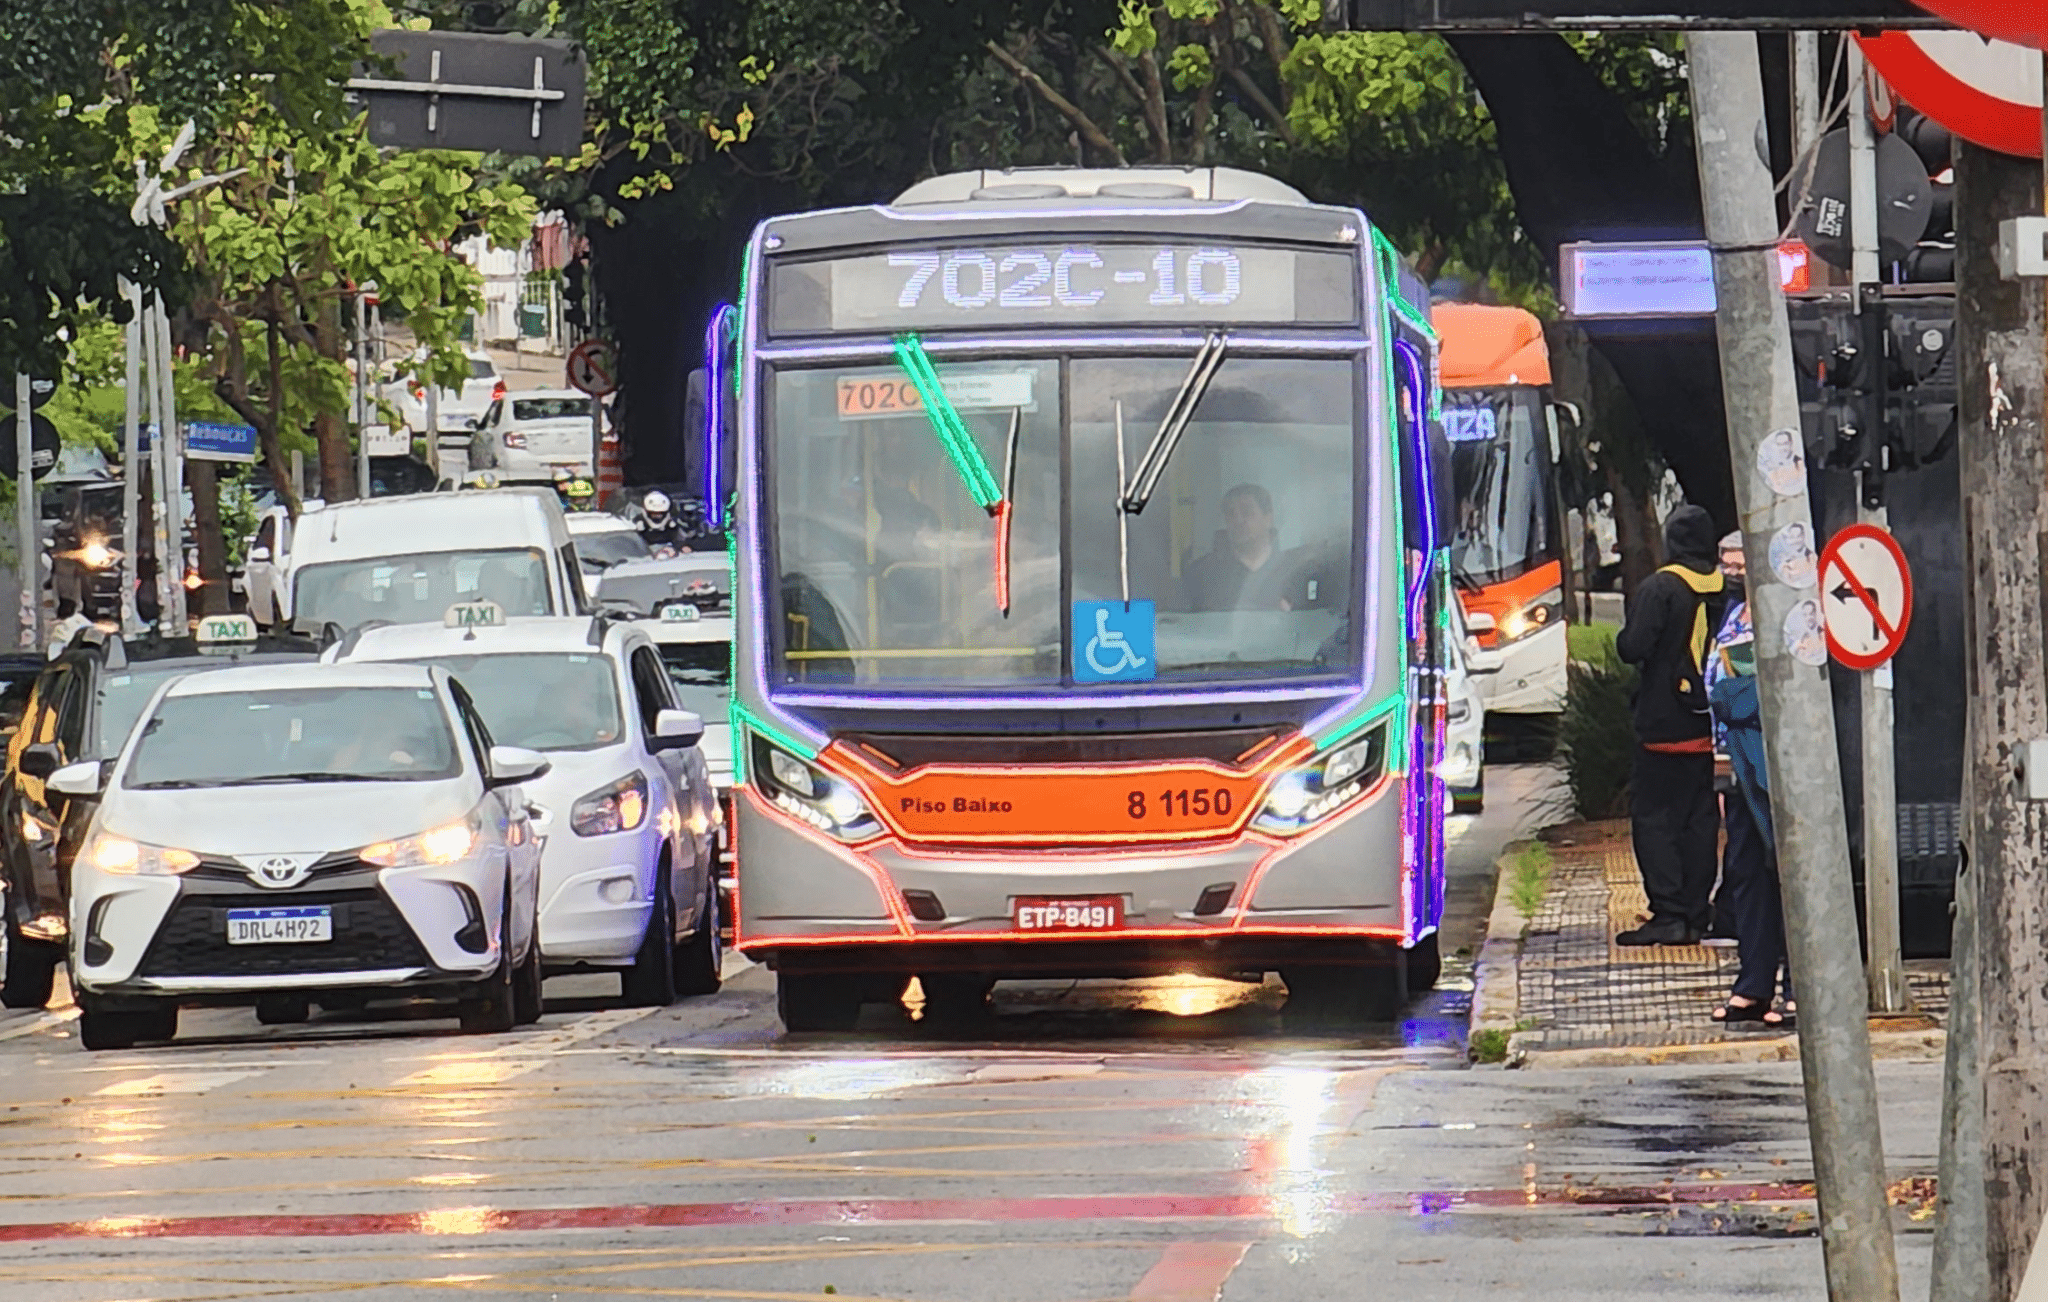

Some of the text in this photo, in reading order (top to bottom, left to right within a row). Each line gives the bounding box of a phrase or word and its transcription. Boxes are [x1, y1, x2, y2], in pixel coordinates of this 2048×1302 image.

[887, 249, 1240, 307] 702C-10
[841, 382, 920, 410] 702C
[453, 606, 495, 625] TAXI
[667, 608, 693, 619] TAXI
[206, 621, 248, 638] TAXI
[901, 797, 1012, 814] Piso Baixo
[1128, 788, 1232, 819] 8 1150
[238, 920, 320, 940] DRL4H92
